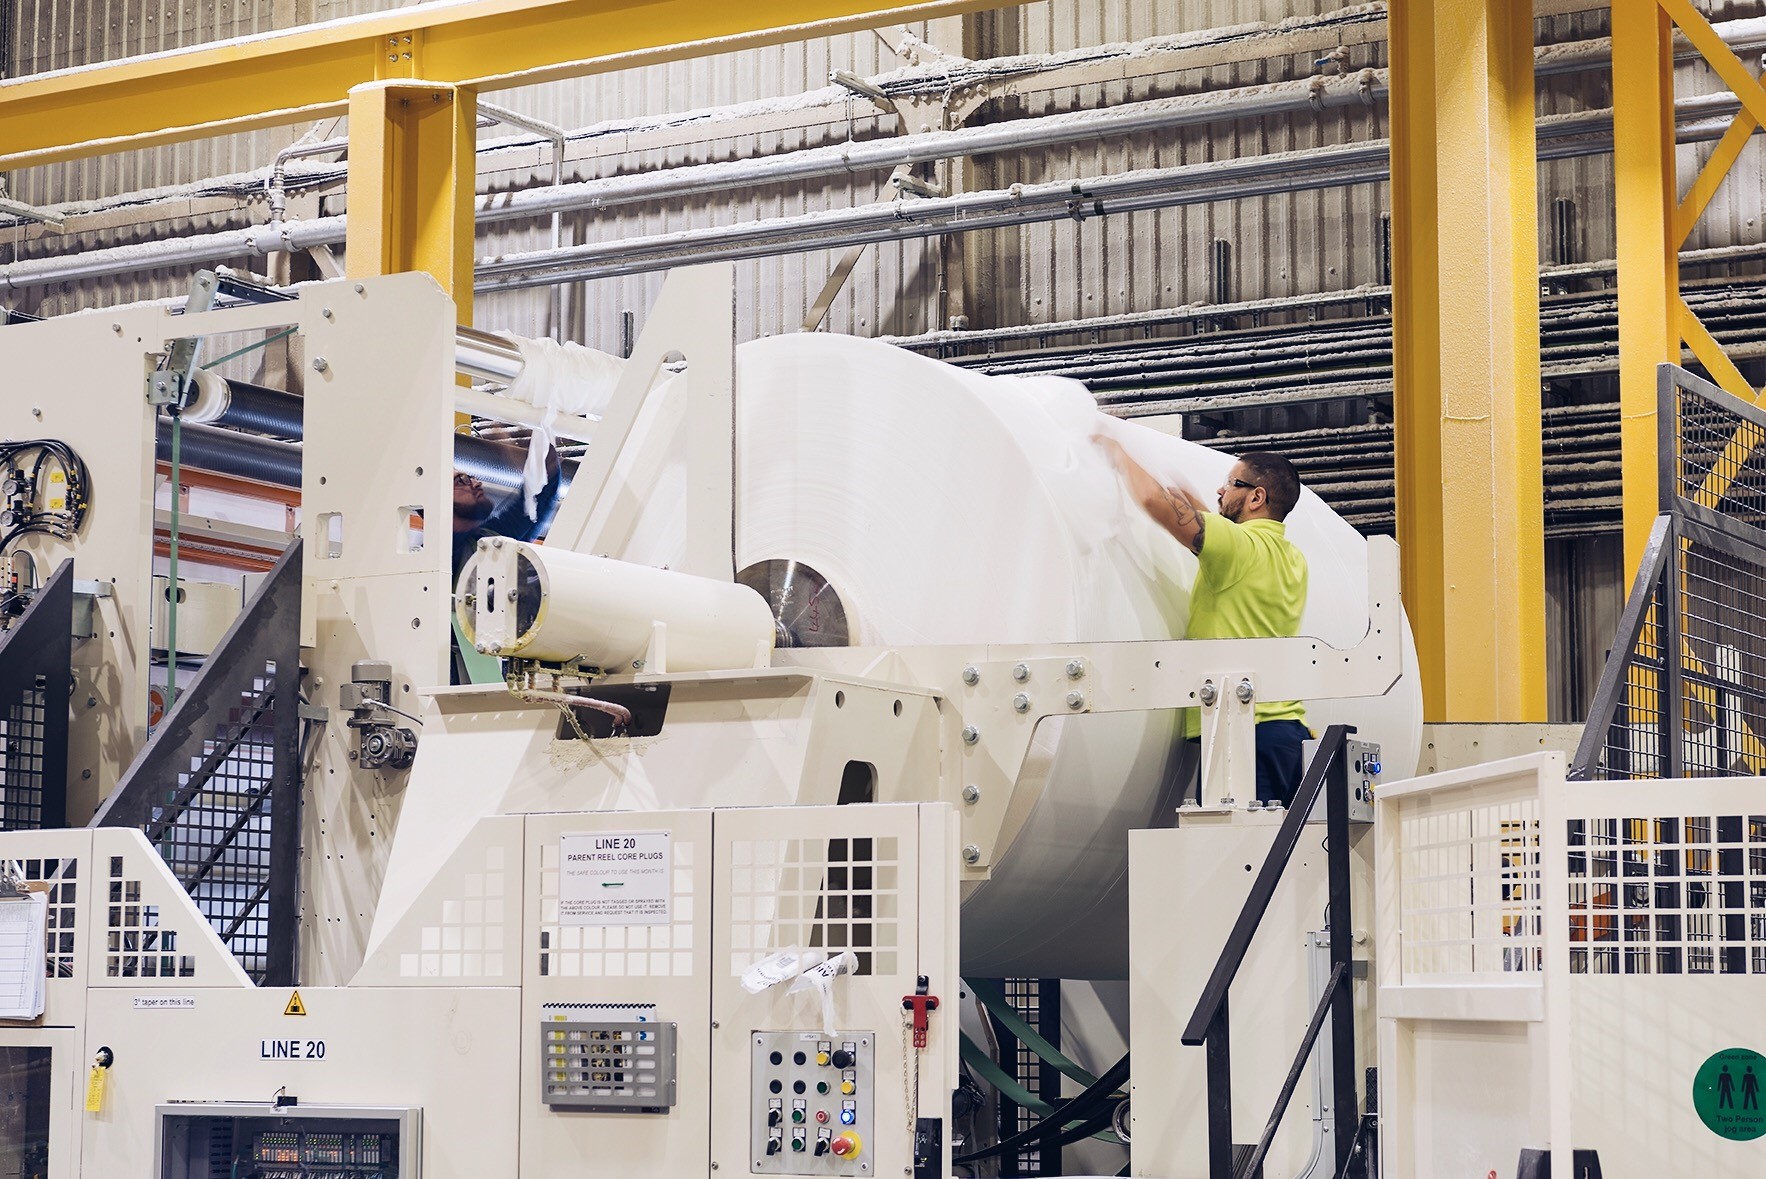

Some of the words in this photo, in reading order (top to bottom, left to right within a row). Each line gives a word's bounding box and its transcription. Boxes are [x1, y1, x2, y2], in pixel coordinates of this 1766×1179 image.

[596, 839, 620, 849] LINE
[623, 838, 636, 849] 20
[262, 1041, 300, 1057] LINE
[306, 1041, 325, 1058] 20
